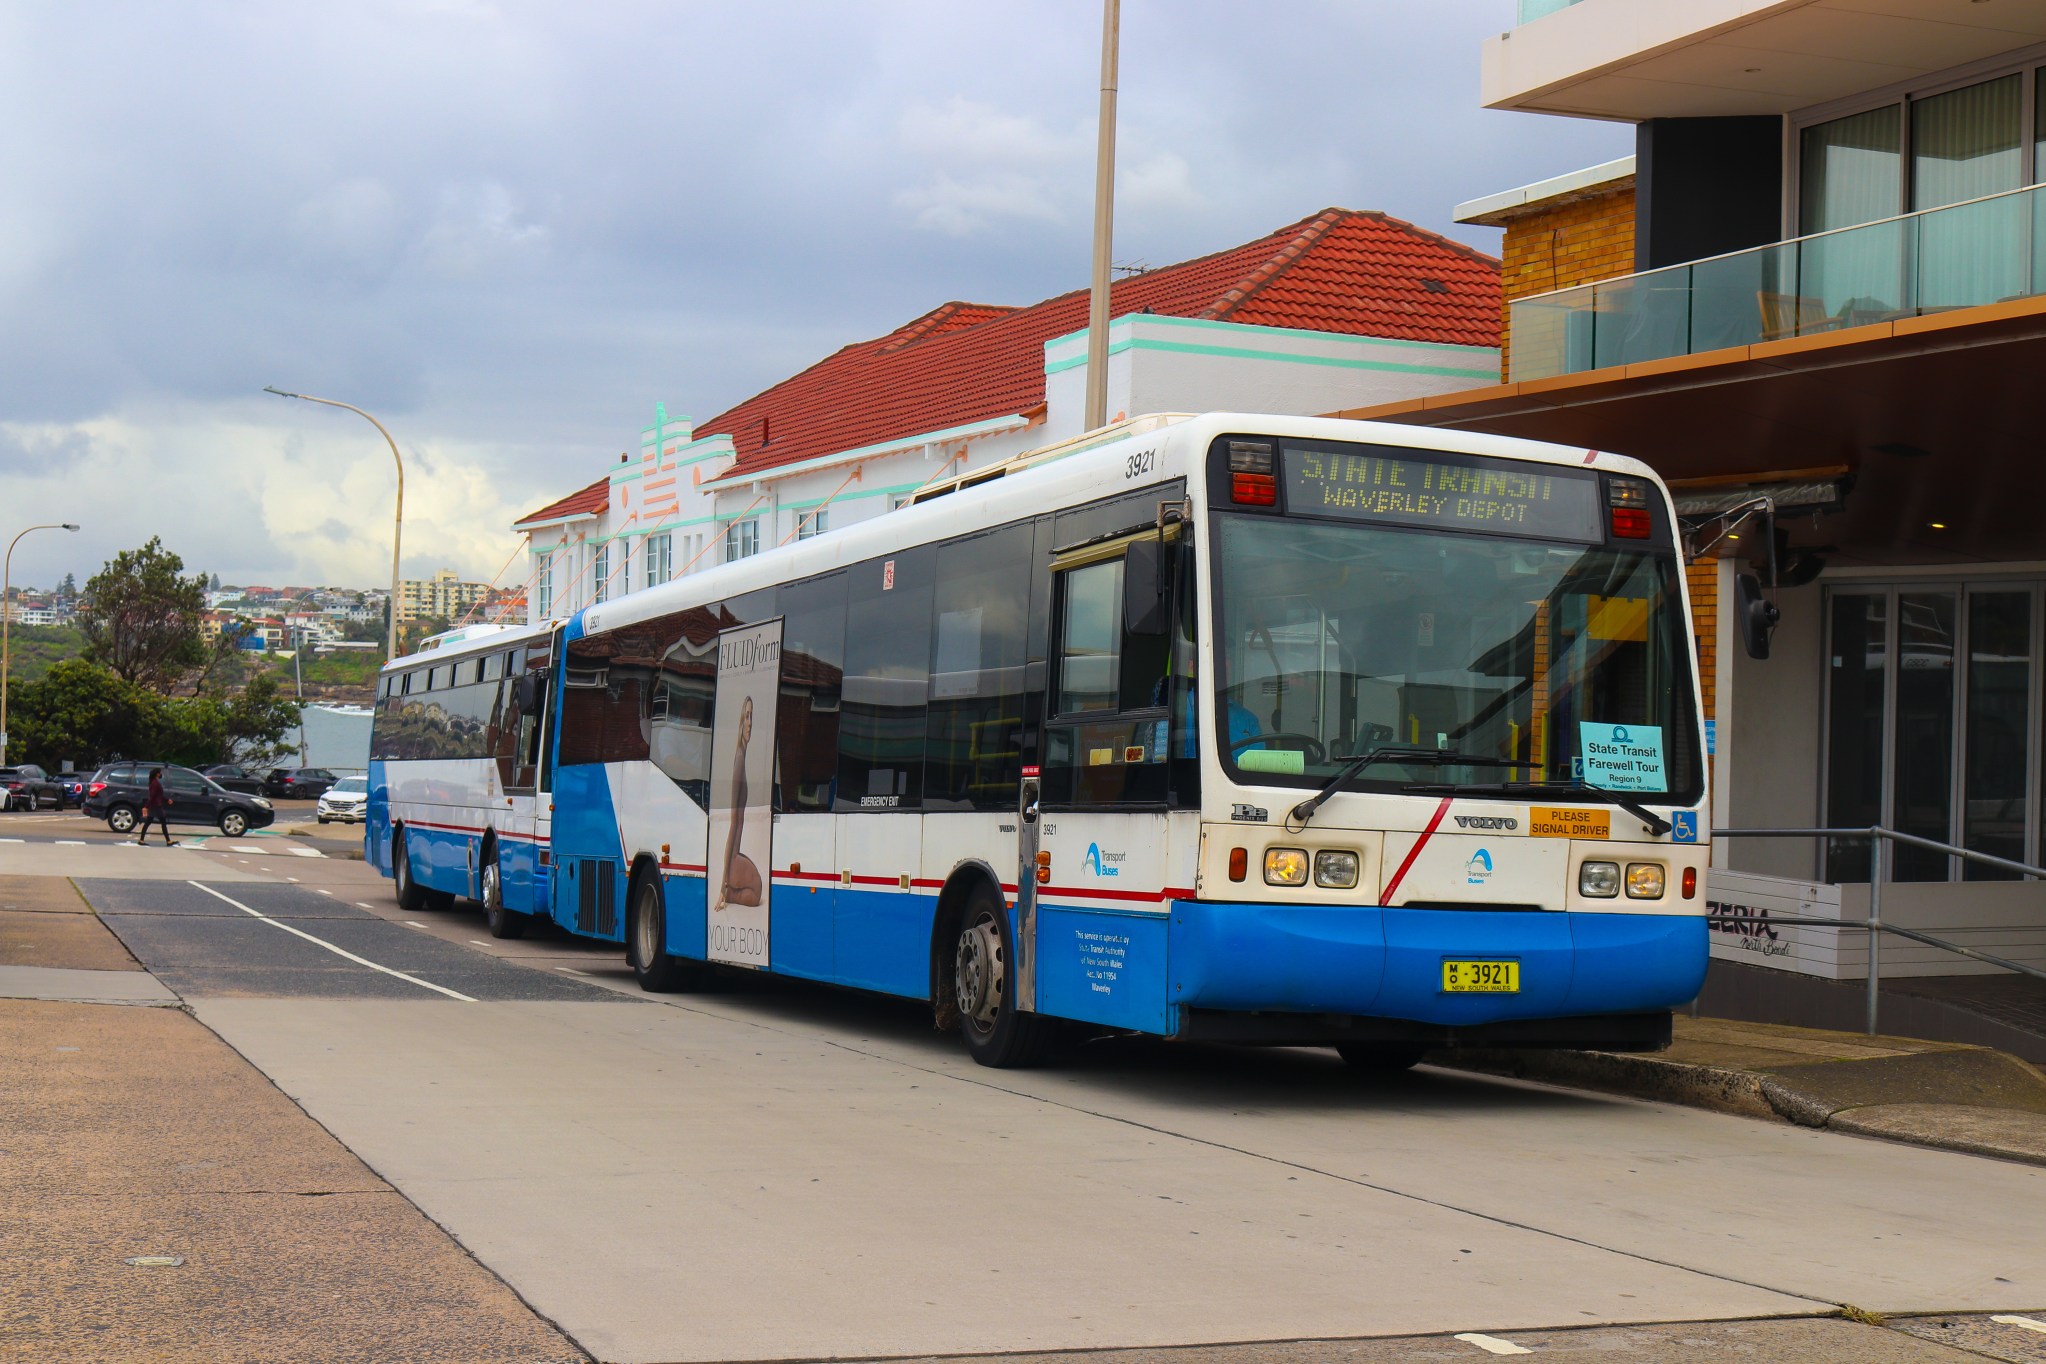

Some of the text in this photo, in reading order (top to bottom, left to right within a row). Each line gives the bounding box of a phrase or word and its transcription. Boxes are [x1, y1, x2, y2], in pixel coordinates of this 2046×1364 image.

[1126, 448, 1156, 479] 3921
[1303, 452, 1406, 486] STATE
[1324, 486, 1527, 522] WAVERLEY DEPOT
[720, 634, 779, 670] FLUIDform
[1588, 742, 1656, 758] State Transit
[1588, 758, 1659, 772] Farewell Tour
[1609, 774, 1635, 783] Region
[861, 796, 899, 806] EMERGENCY EXIT
[1552, 811, 1590, 822] PLEASE
[1454, 816, 1518, 830] VOLVO
[1043, 824, 1057, 835] 3921
[1532, 824, 1608, 835] SIGNAL DRIVER
[1102, 851, 1126, 863] Transport
[1102, 865, 1118, 876] Buses
[709, 925, 769, 956] YOUR BODY
[1084, 932, 1098, 940] service
[1090, 945, 1104, 954] Transit
[1105, 946, 1125, 958] Authority
[1740, 937, 1790, 956] North Bondi
[1097, 958, 1109, 967] South
[1110, 960, 1122, 968] Wales
[1092, 983, 1110, 995] Waverley
